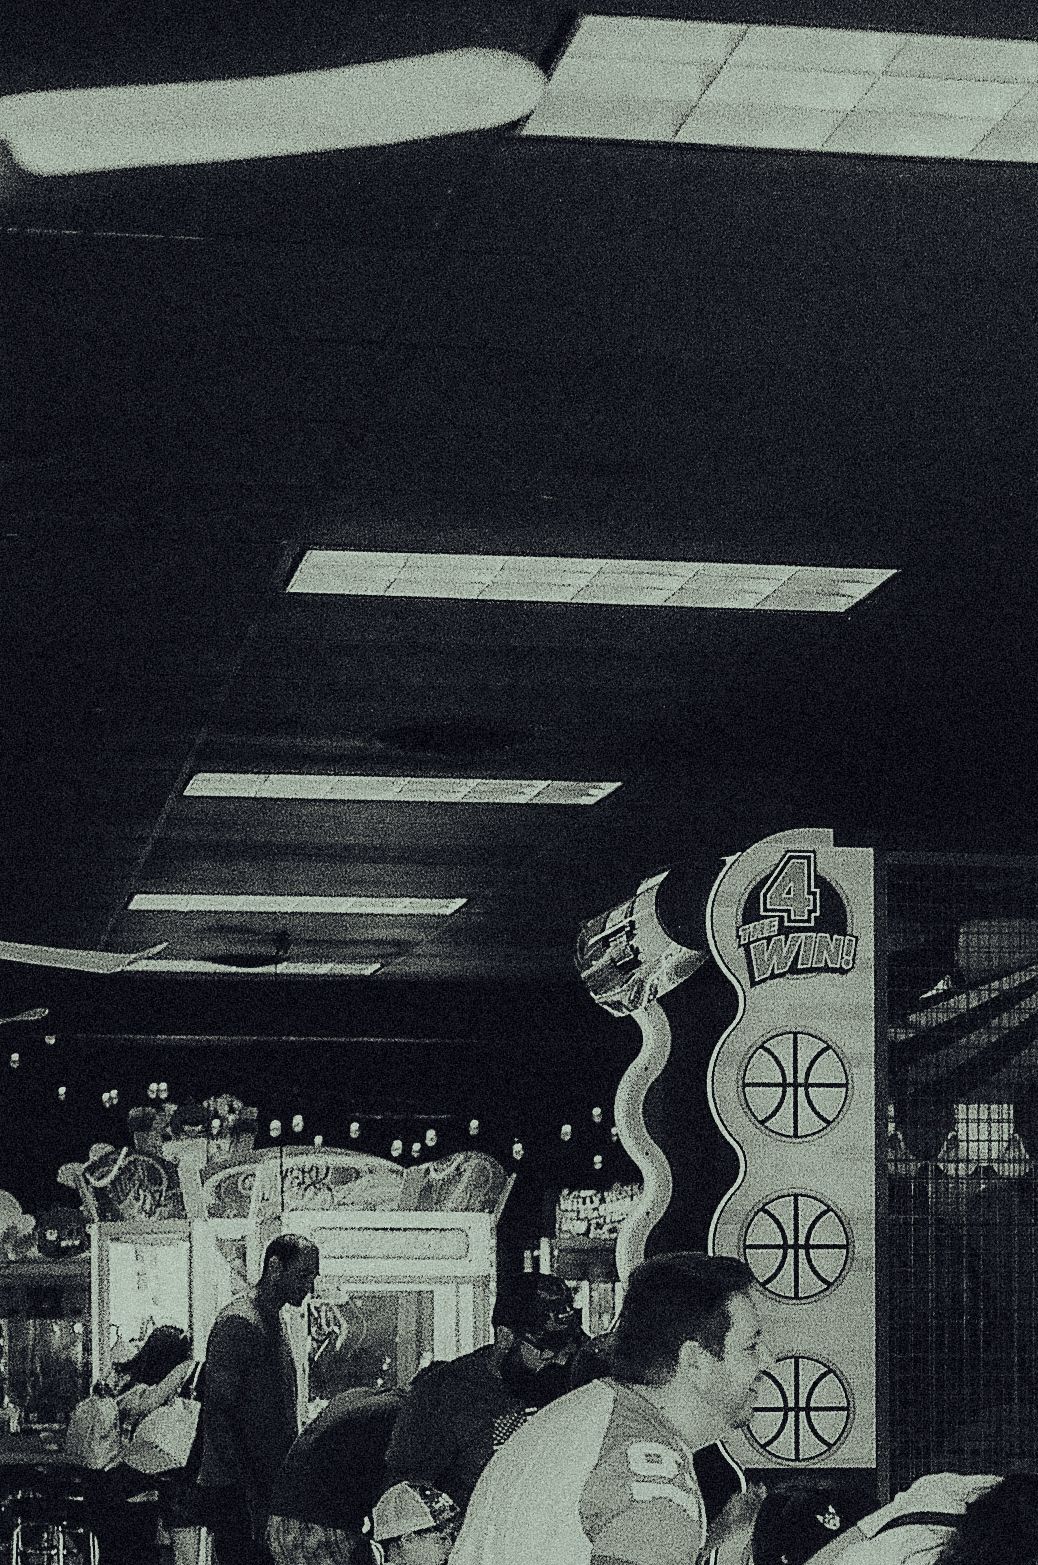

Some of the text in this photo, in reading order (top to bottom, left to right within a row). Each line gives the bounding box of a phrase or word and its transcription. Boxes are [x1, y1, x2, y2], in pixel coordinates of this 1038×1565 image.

[760, 851, 820, 926] 4
[739, 918, 779, 944] THE
[750, 933, 858, 981] WIN!
